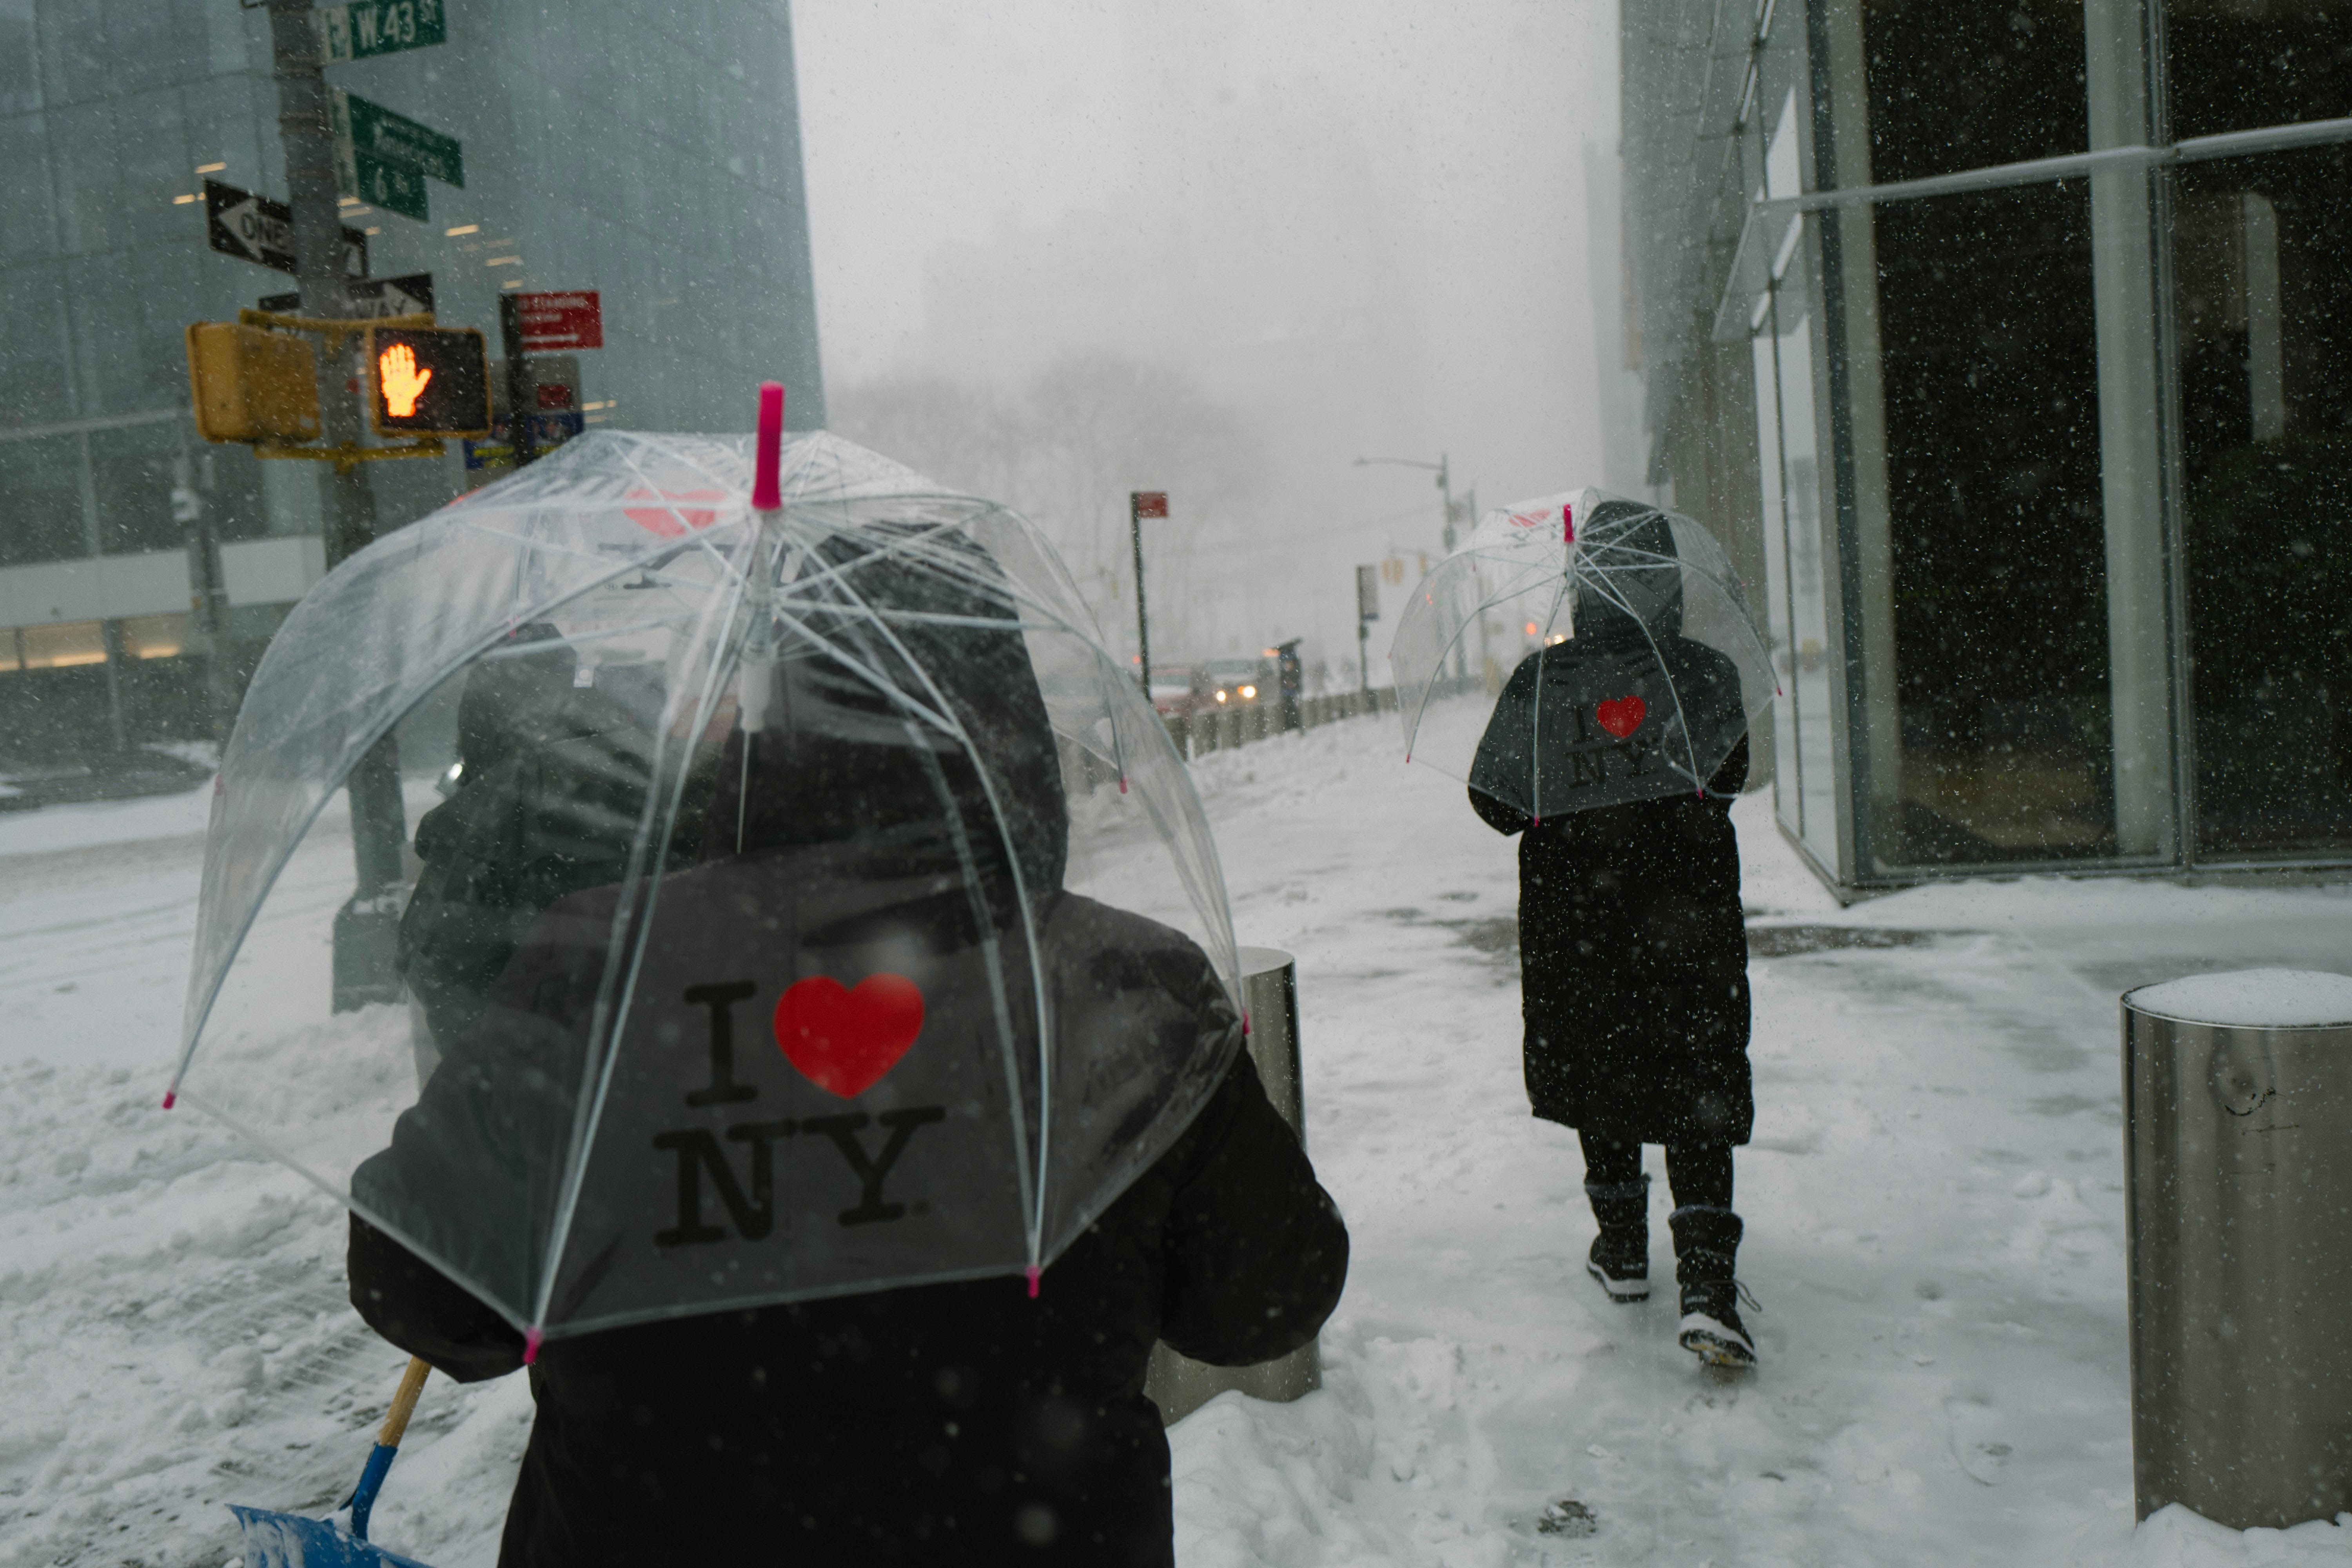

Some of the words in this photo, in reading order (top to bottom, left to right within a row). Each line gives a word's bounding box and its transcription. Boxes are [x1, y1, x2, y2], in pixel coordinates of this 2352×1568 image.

[356, 5, 377, 49] W
[383, 2, 416, 43] 43
[374, 165, 388, 201] 6
[240, 212, 289, 250] ONE
[1566, 704, 1595, 744] I
[1566, 737, 1659, 789] NY
[684, 980, 757, 1107] I
[653, 1106, 946, 1249] NY
